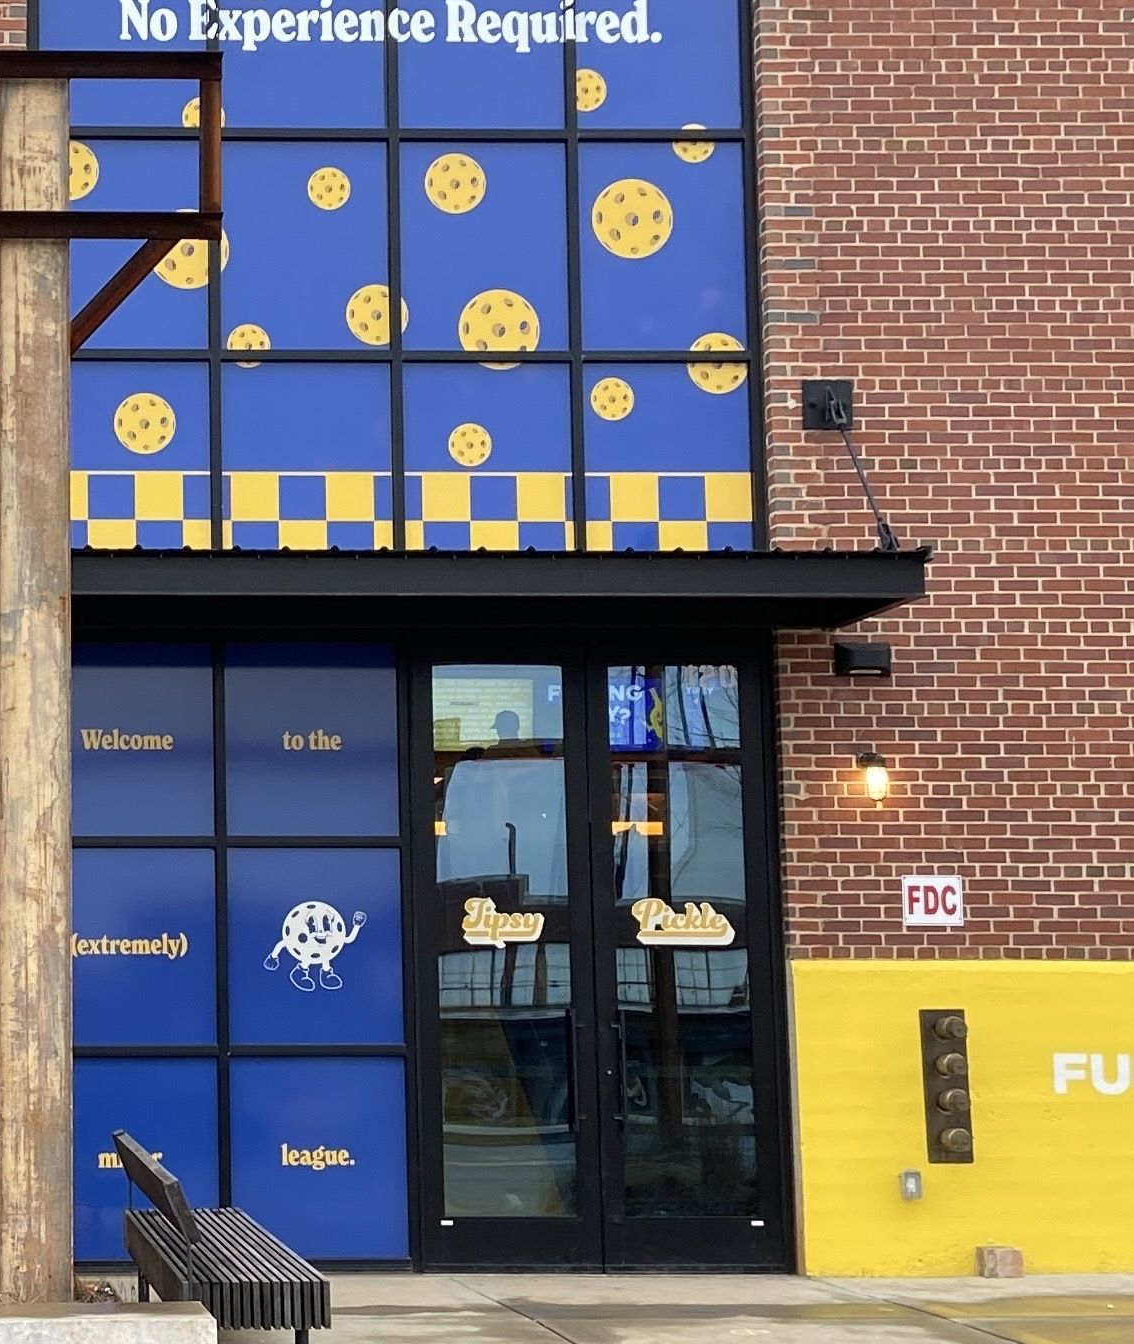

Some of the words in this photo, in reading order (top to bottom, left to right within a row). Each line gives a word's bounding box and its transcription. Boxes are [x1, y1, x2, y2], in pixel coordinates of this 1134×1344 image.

[80, 728, 174, 751] Welcome
[282, 730, 305, 751] to
[307, 729, 342, 751] the
[907, 885, 957, 915] FDC
[462, 897, 545, 949] Tipsy
[631, 897, 735, 946] Pickle
[69, 932, 189, 960] (extremely)
[280, 1143, 356, 1171] league.
